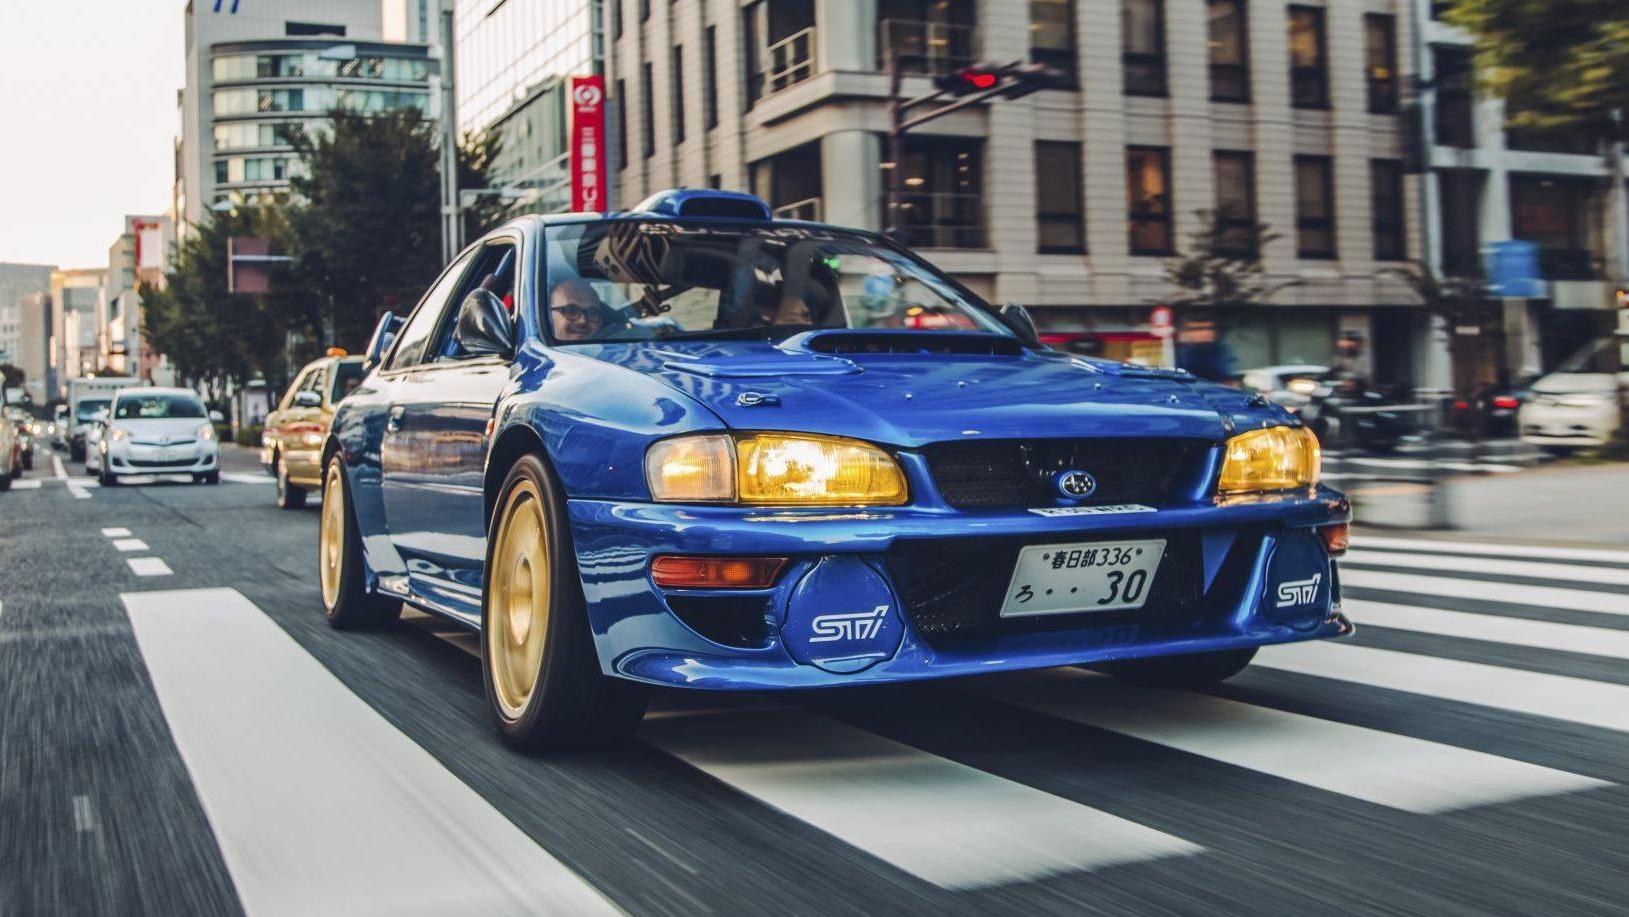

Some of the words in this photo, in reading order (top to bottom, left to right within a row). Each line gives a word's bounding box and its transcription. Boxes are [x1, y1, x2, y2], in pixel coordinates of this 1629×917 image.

[1051, 547, 1134, 569] 春日部336
[1015, 585, 1034, 603] ろ
[1097, 569, 1148, 604] 30
